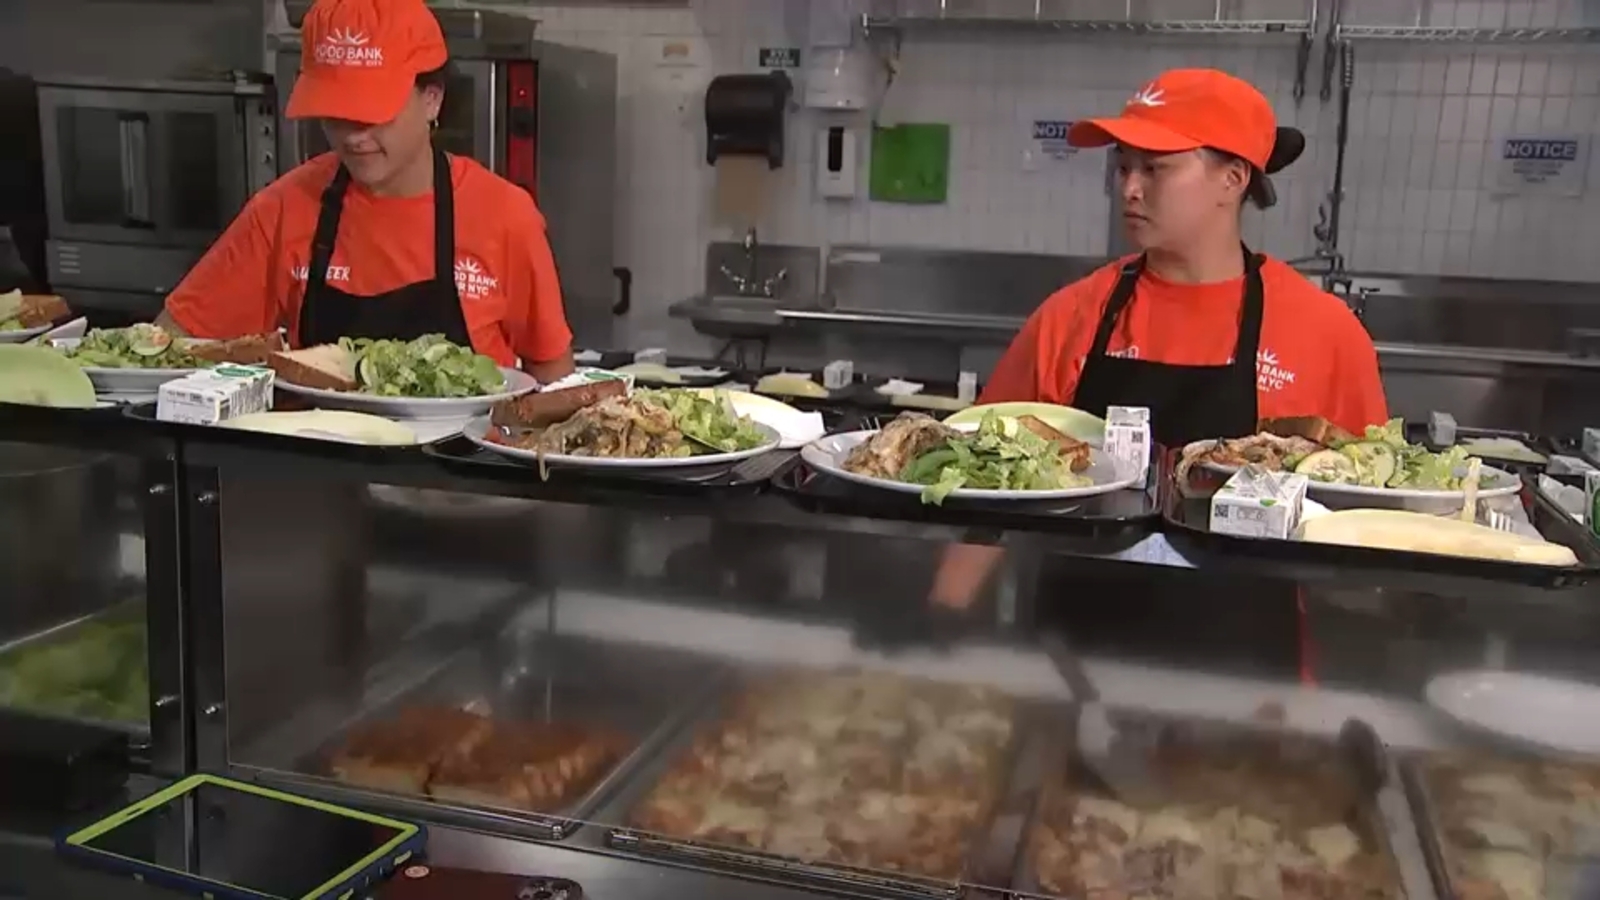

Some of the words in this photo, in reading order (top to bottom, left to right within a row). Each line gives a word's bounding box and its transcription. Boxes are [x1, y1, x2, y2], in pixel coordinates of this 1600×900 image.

[346, 46, 383, 60] BANK
[1034, 124, 1067, 138] NOT
[1506, 142, 1576, 158] NOTICE
[467, 273, 499, 289] BANK
[467, 283, 489, 296] NYC
[1258, 374, 1284, 390] NYC
[1261, 364, 1296, 384] BANK
